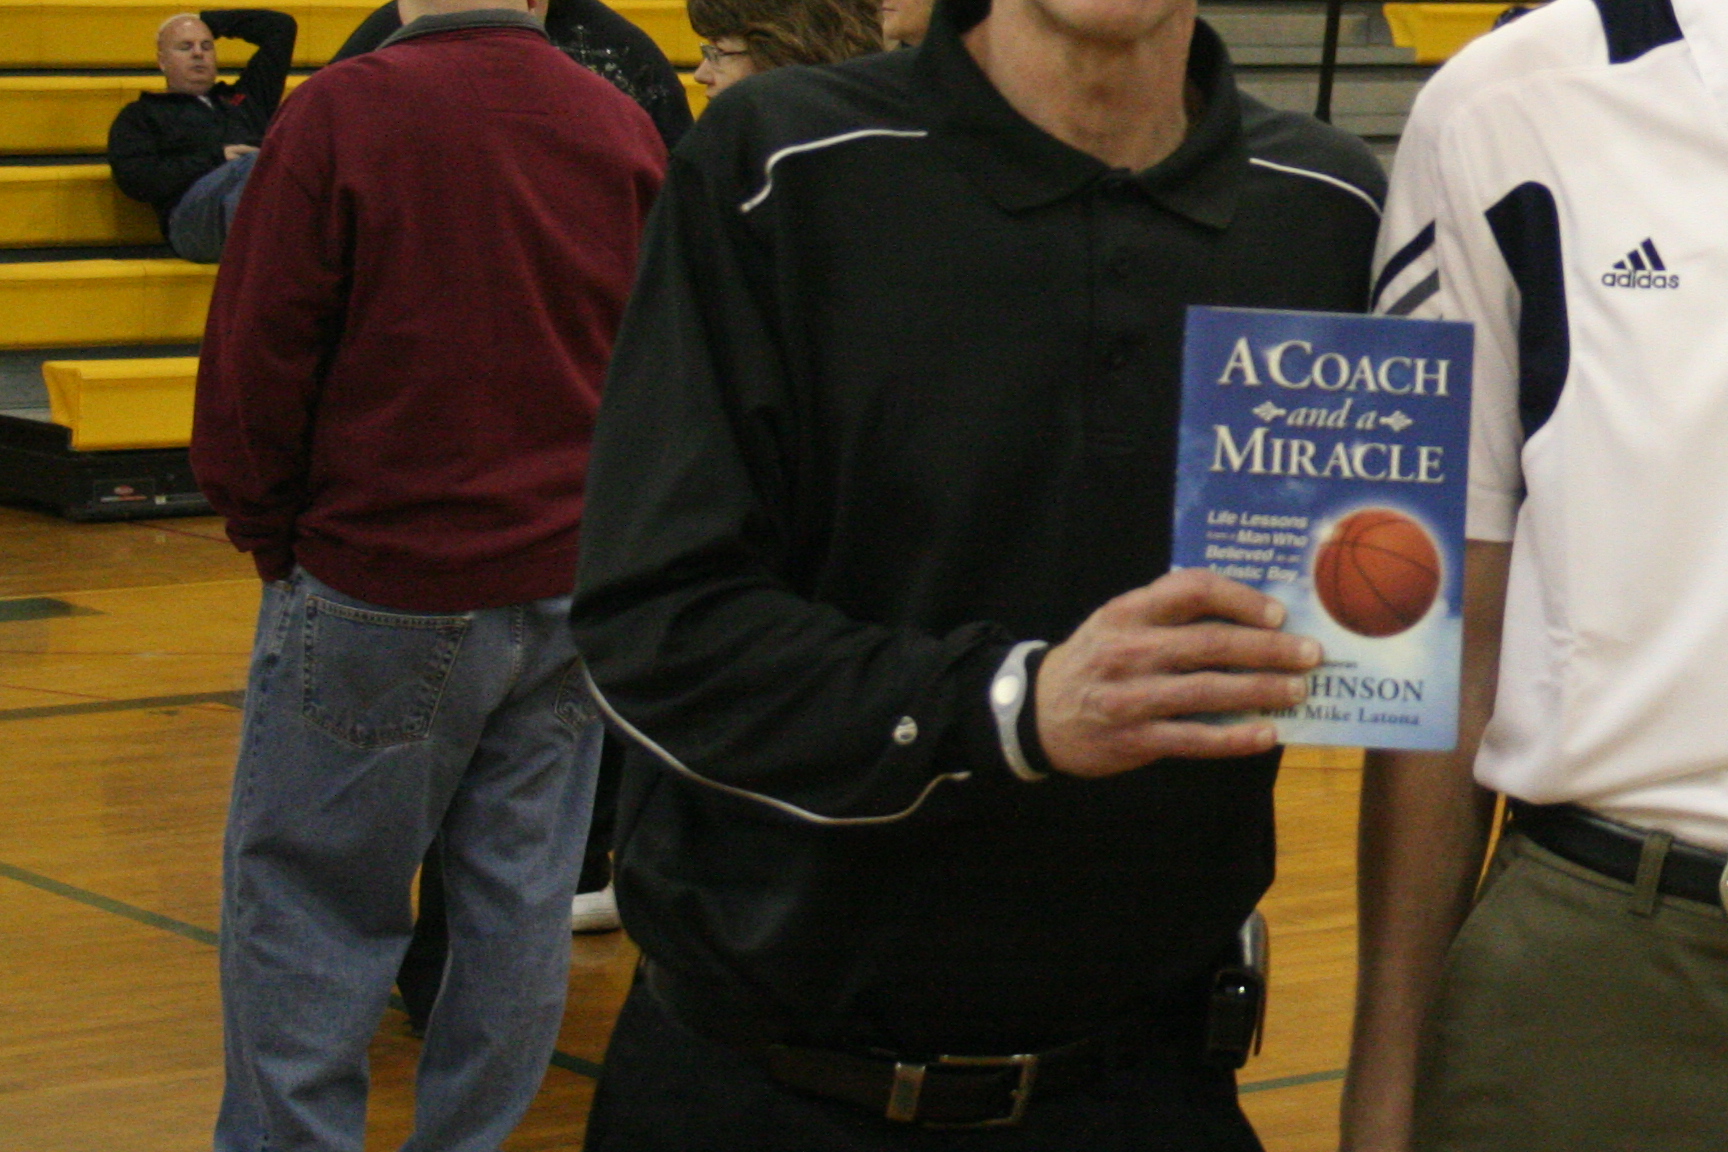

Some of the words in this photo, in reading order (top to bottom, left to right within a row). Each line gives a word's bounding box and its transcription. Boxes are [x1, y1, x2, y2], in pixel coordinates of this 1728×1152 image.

[1601, 269, 1680, 290] adidas
[1217, 337, 1262, 386] A
[1286, 398, 1354, 429] and
[1355, 410, 1378, 430] a
[1207, 510, 1239, 526] Life
[1240, 511, 1309, 529] Lessons
[1236, 529, 1271, 545] Man
[1272, 532, 1309, 548] Who
[1205, 544, 1275, 562] Believed
[1310, 674, 1424, 702] HNSON
[1305, 703, 1351, 721] Mike
[1358, 707, 1419, 726] Latona
